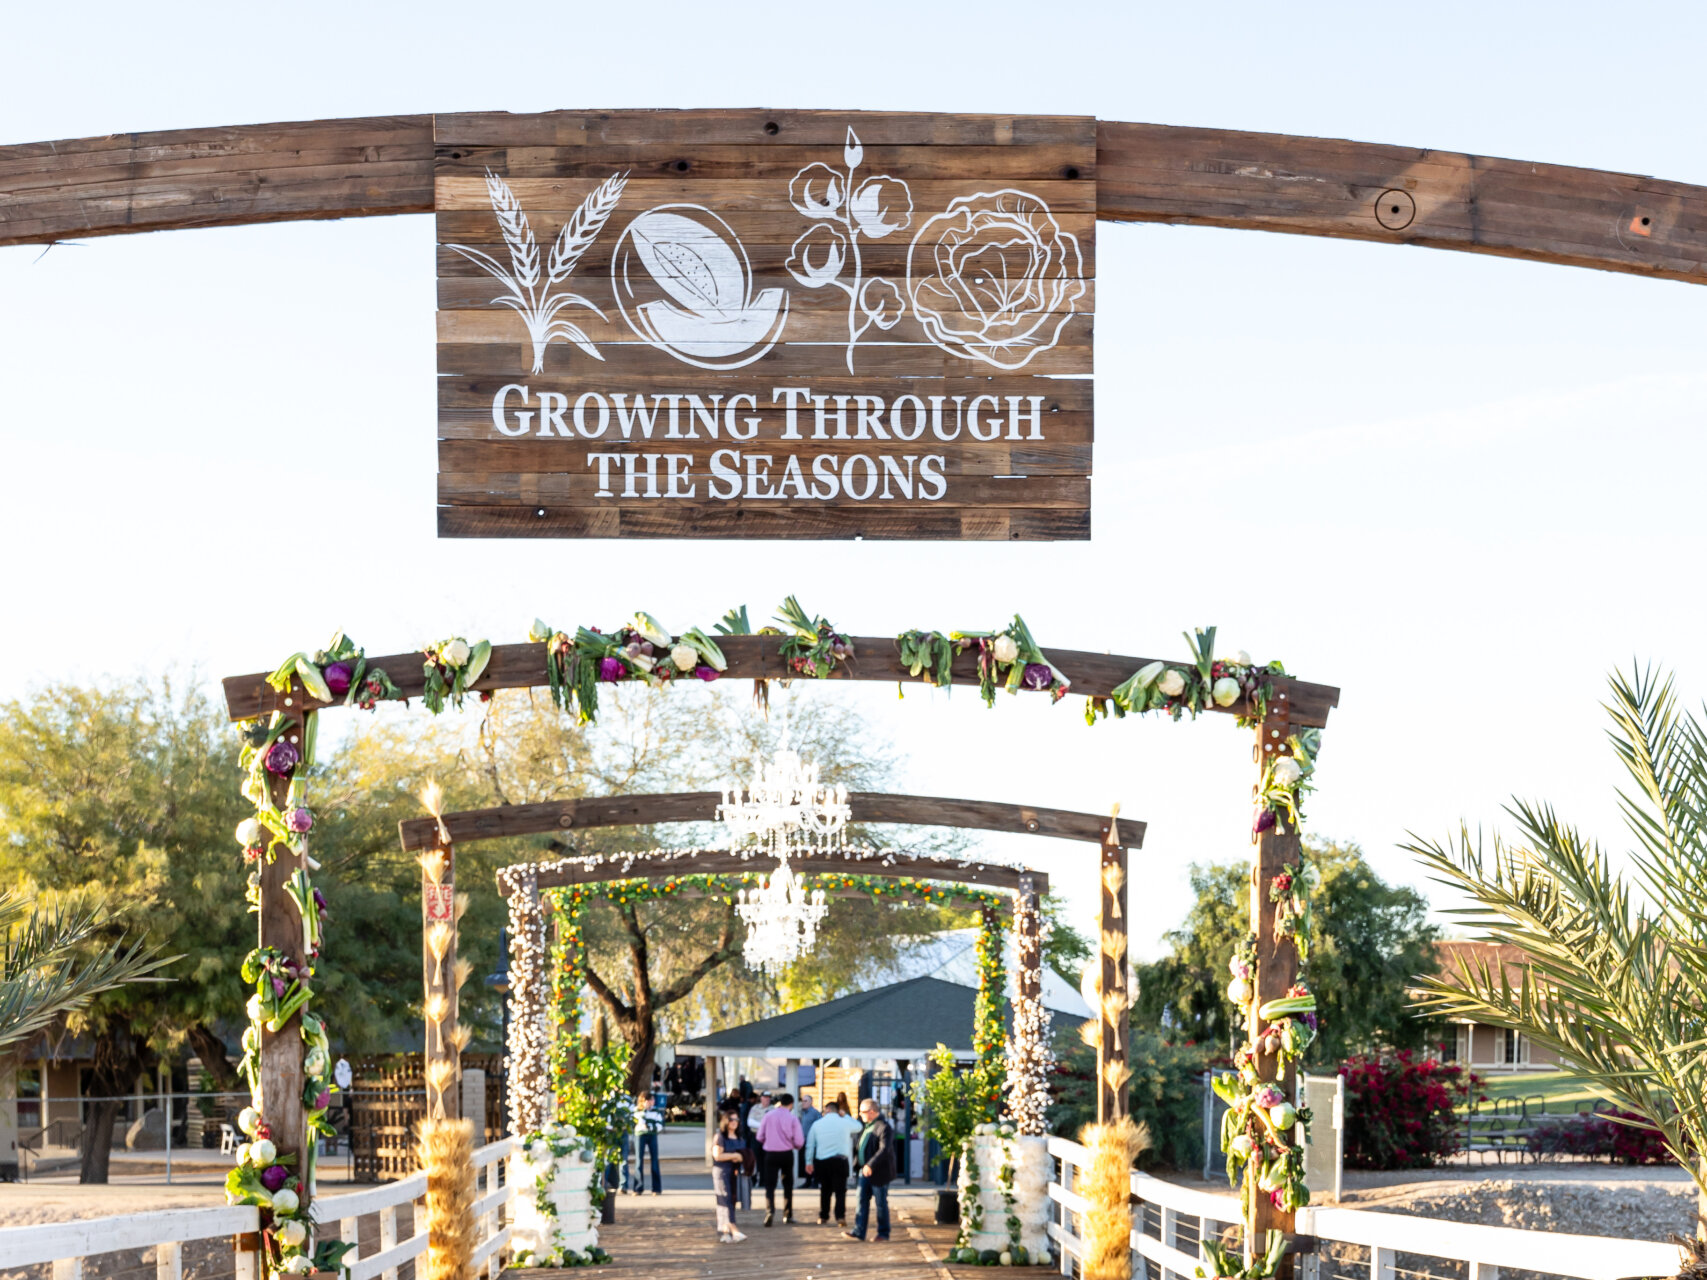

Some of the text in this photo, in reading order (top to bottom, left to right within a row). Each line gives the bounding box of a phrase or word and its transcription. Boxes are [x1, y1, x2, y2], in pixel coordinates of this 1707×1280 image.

[492, 384, 1046, 441] GROWING THROUGH
[587, 449, 948, 501] THE SEASONS
